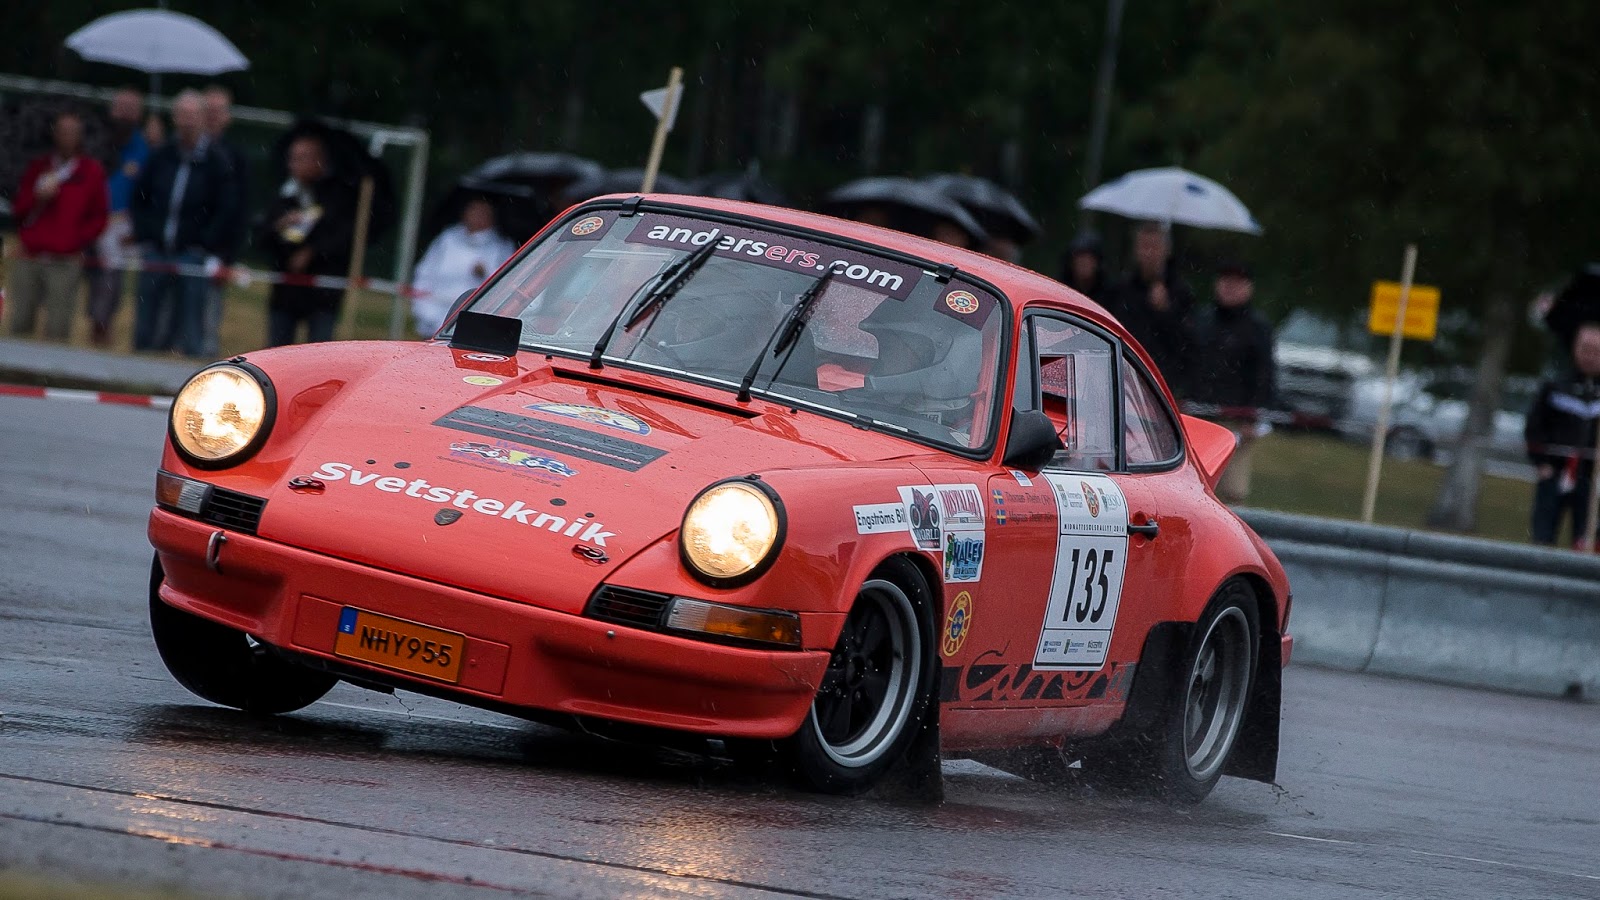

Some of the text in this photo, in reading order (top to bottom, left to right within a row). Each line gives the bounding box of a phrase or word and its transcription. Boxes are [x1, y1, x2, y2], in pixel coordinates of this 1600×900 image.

[647, 224, 904, 291] andersers.com
[311, 462, 617, 548] Svetsteknik
[856, 510, 895, 529] Engströms
[914, 528, 940, 541] WORLD
[1062, 548, 1114, 623] 135
[360, 625, 453, 668] NHY955
